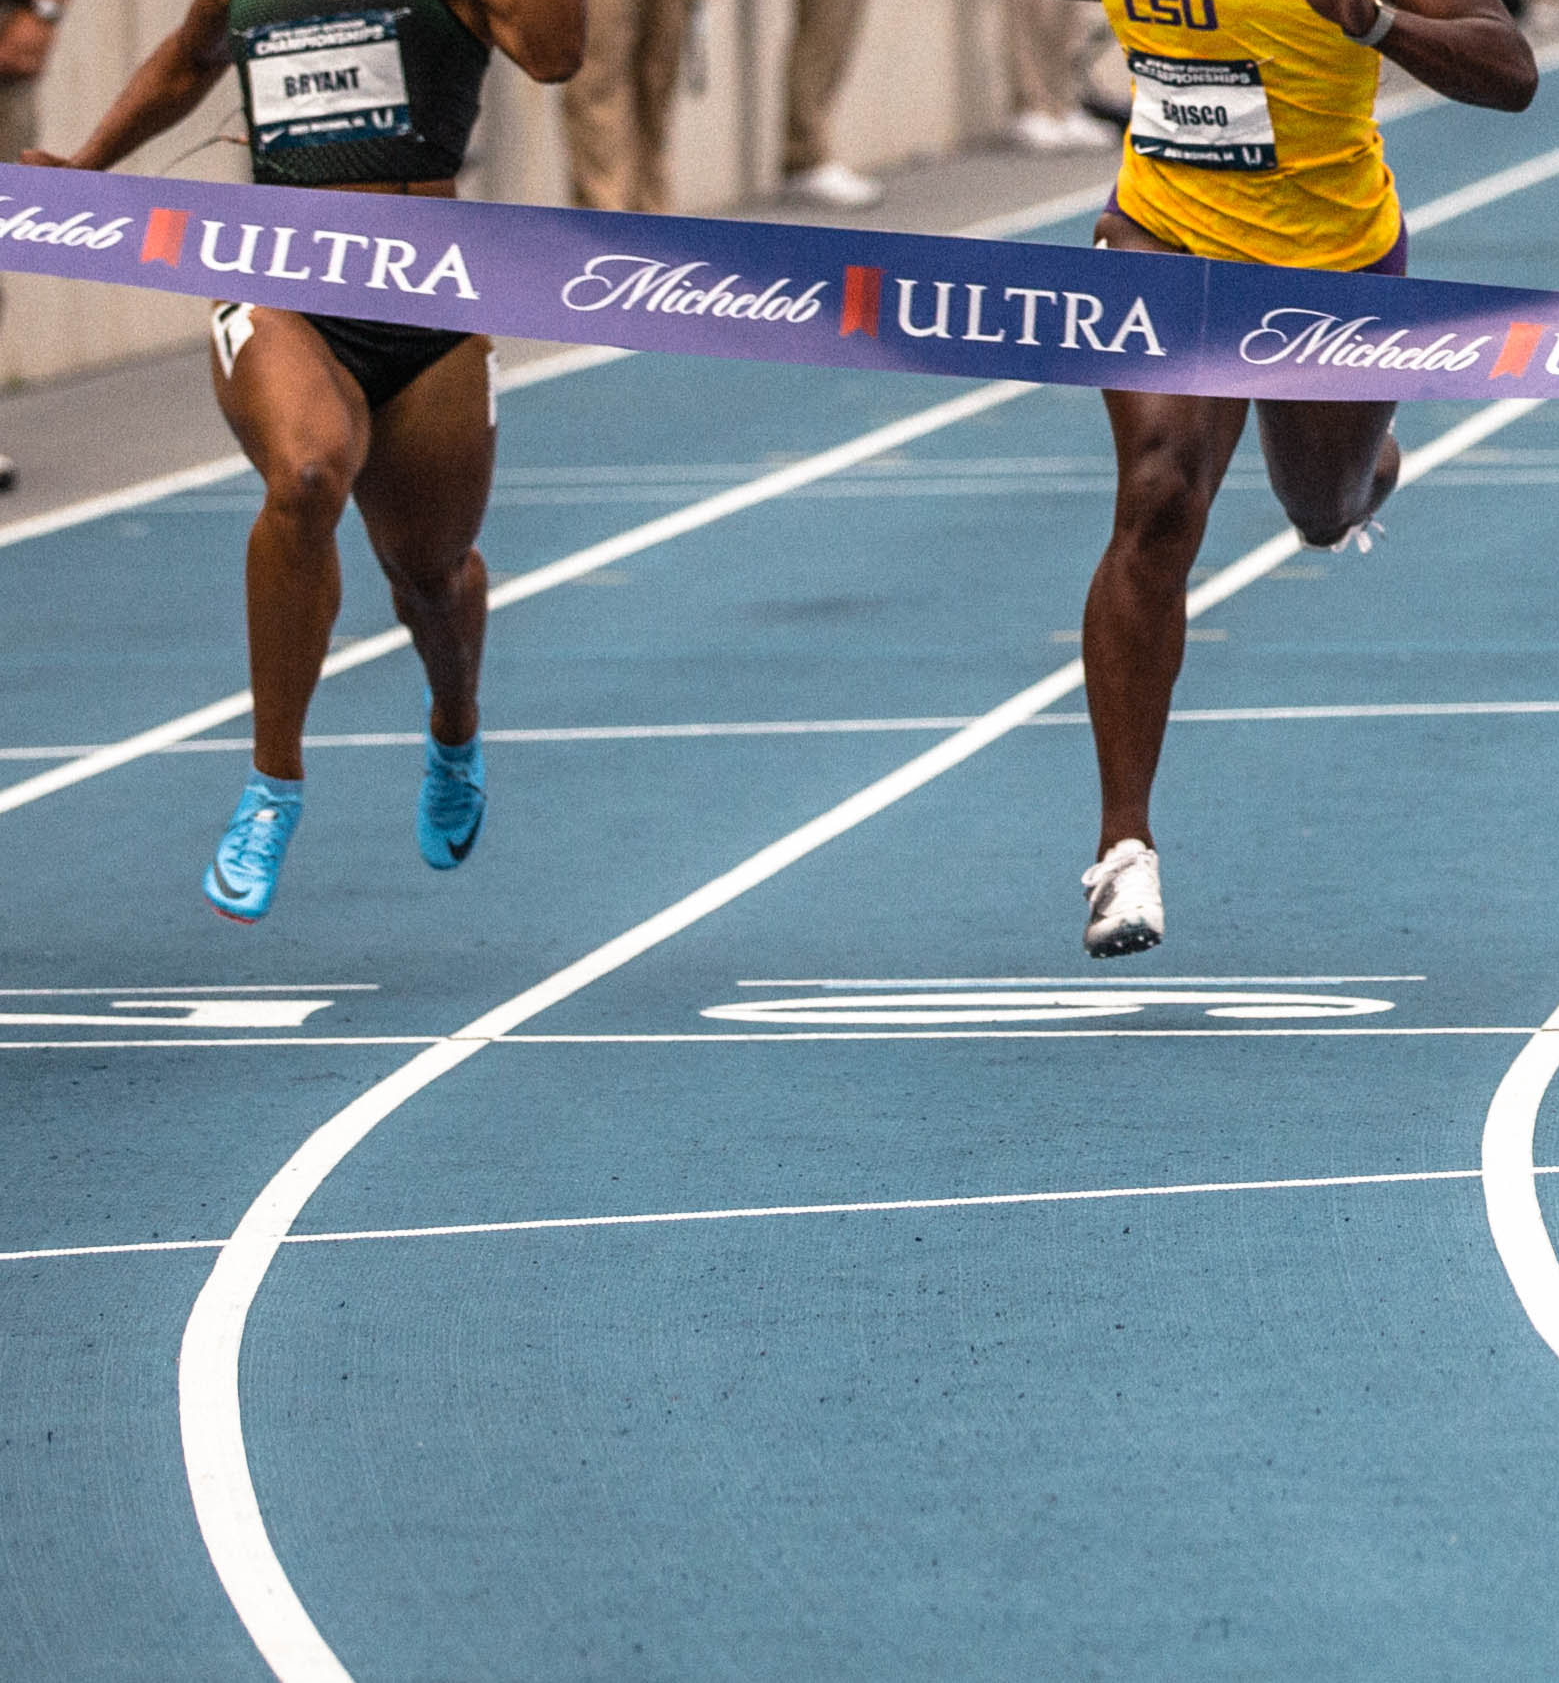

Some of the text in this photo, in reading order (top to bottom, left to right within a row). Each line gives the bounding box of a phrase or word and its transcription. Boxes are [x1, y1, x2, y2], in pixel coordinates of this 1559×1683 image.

[283, 67, 360, 98] BRYANT
[199, 220, 480, 300] ULTRA
[561, 254, 1167, 356] Michelob ULTRA
[1239, 308, 1492, 372] Michelob
